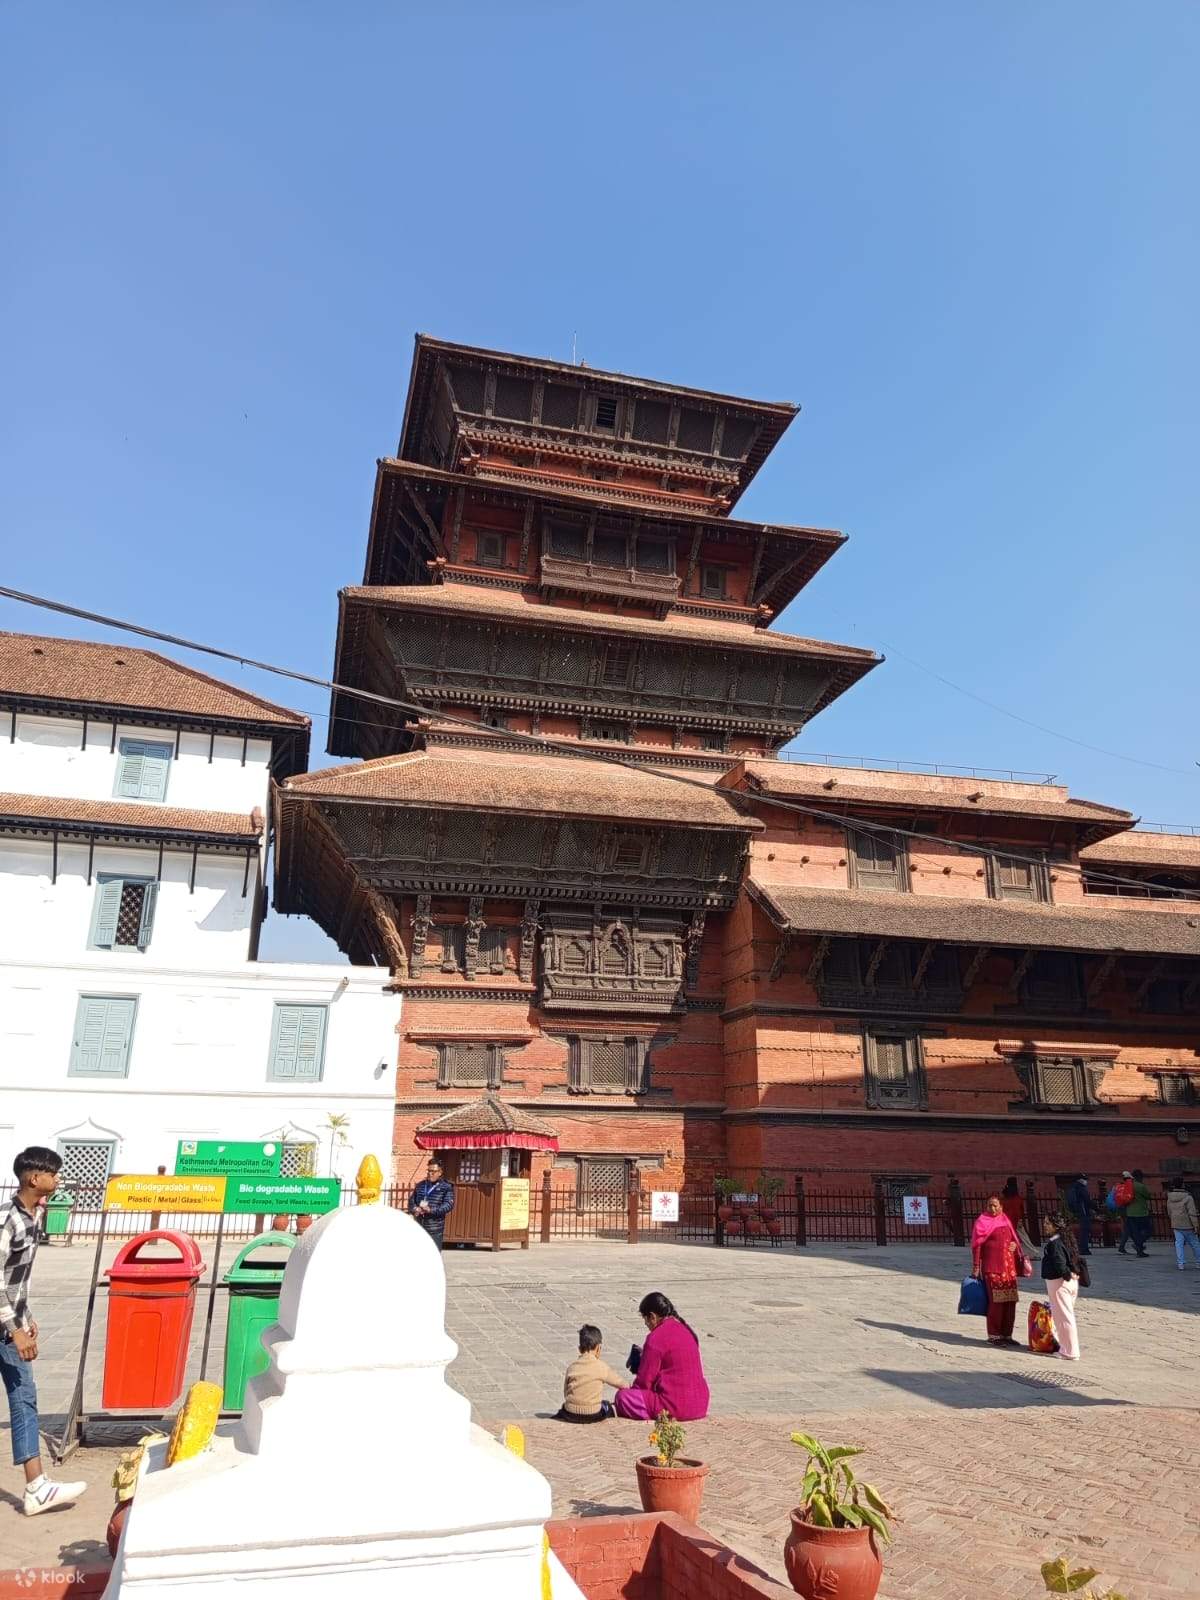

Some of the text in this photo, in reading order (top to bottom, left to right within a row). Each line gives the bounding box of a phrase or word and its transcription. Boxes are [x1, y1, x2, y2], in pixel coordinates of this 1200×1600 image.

[179, 1158, 275, 1168] Kathmandu Metropolitan City
[135, 1183, 190, 1192] Biodegradable
[192, 1184, 216, 1192] Waste
[239, 1184, 330, 1195] Bio degradable Waste
[127, 1195, 152, 1203] Plastic
